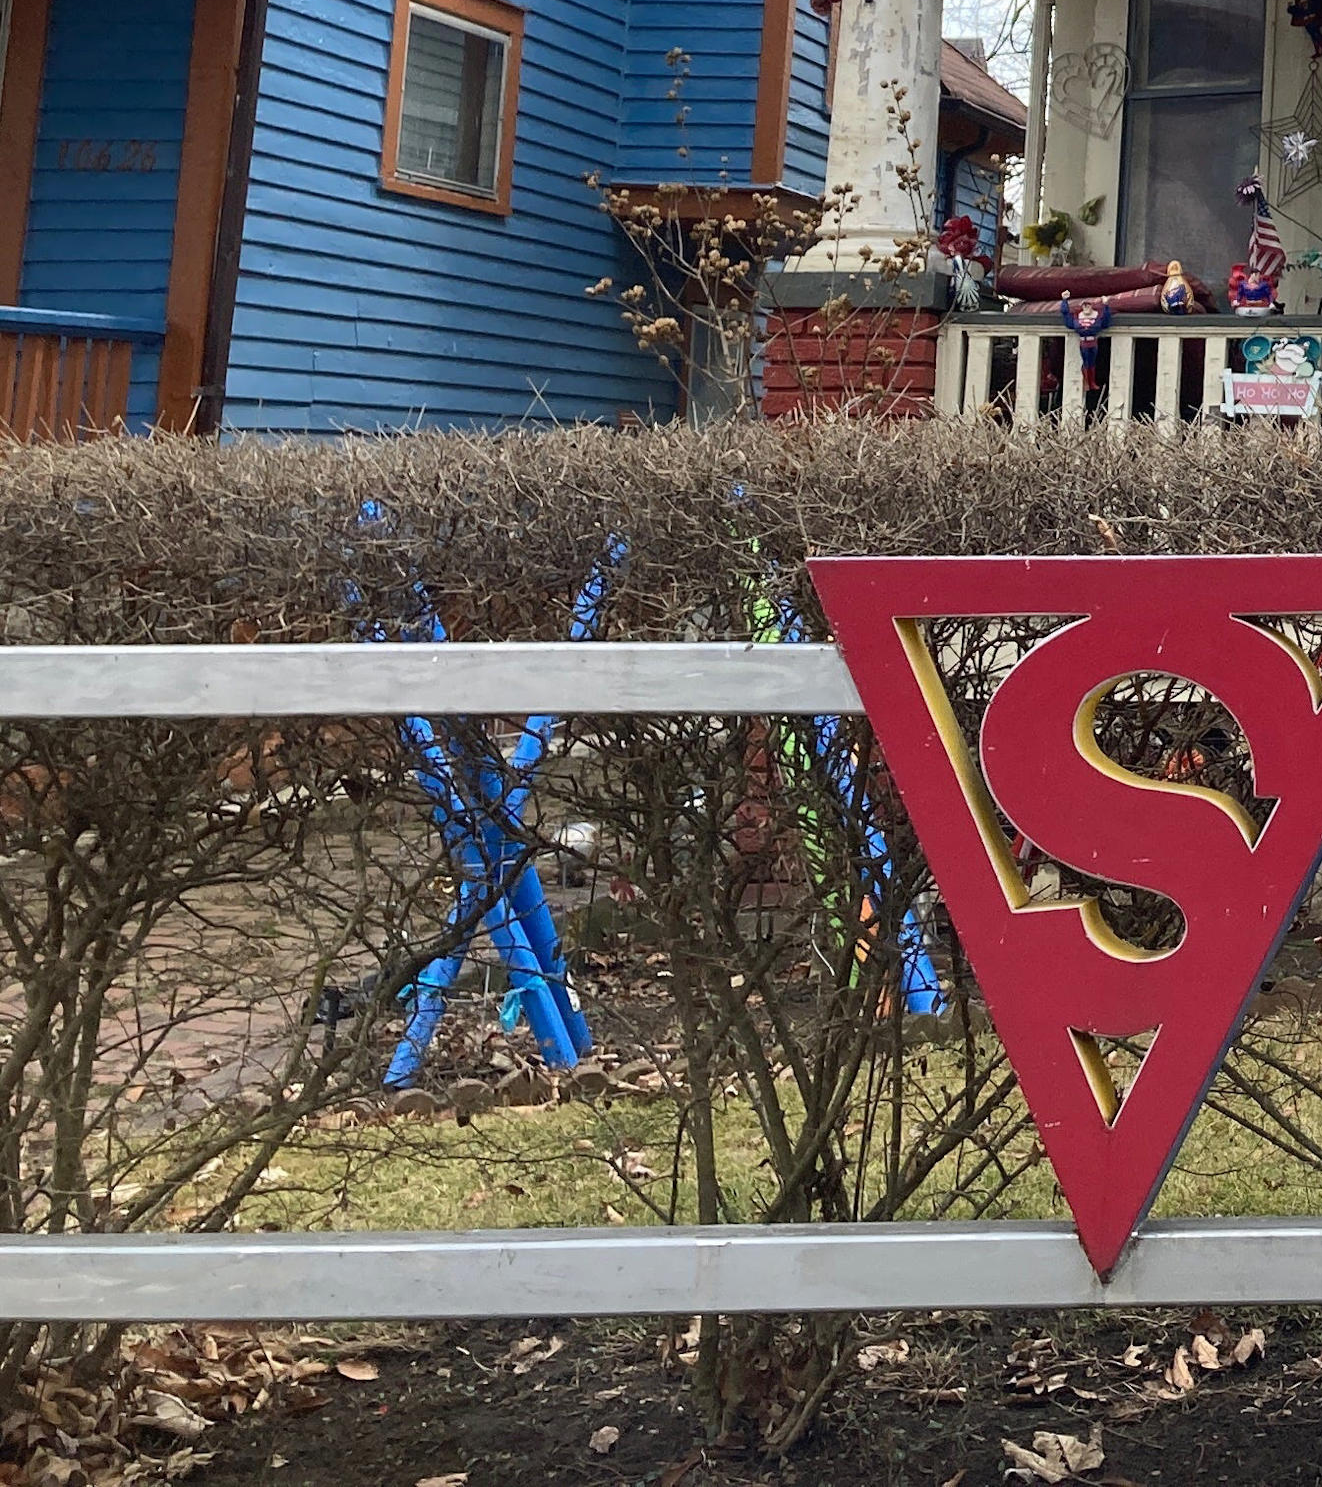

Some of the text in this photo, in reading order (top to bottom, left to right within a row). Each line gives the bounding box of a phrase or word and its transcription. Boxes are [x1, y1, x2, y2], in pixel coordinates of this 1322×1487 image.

[1236, 386, 1306, 400] HO HO HO
